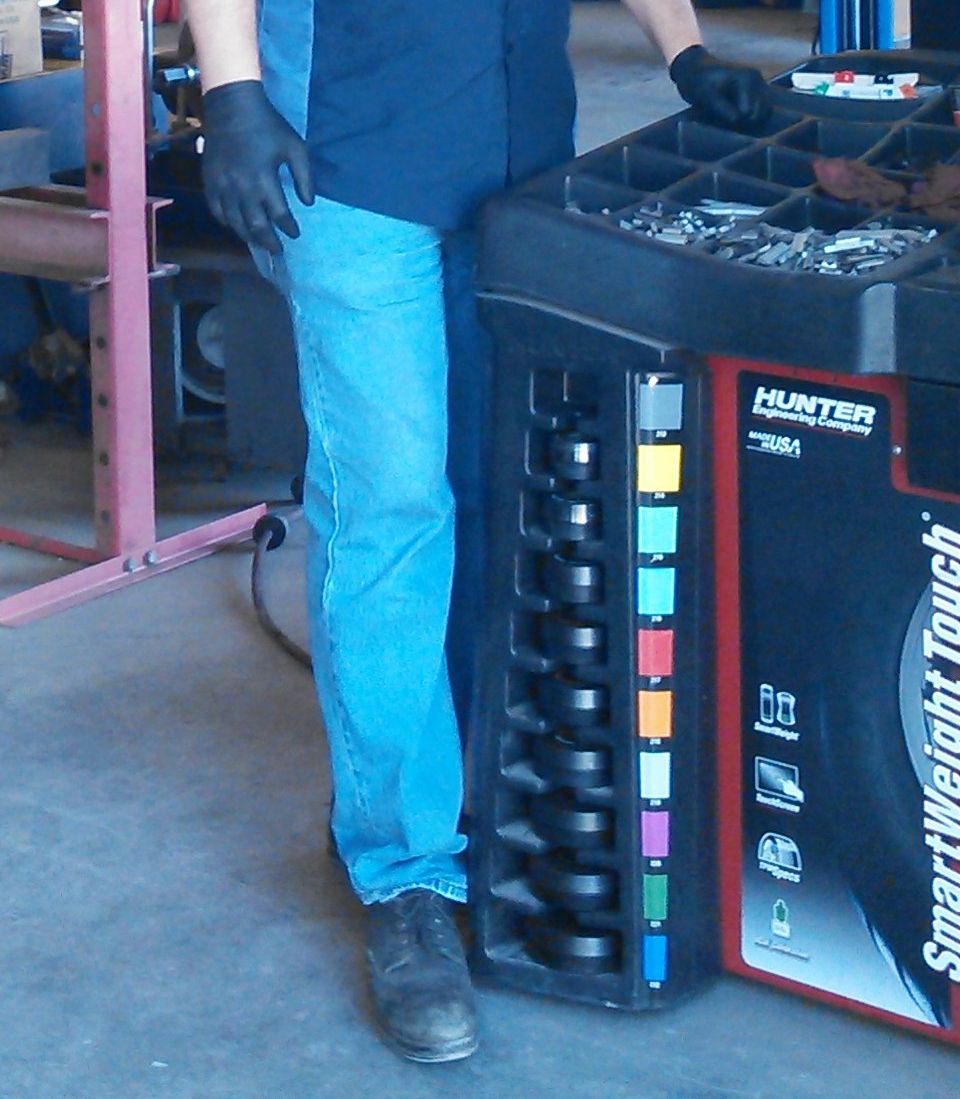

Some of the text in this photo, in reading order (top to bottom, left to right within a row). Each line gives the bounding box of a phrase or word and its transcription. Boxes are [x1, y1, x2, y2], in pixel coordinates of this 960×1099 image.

[754, 386, 877, 425] HUNTER
[752, 404, 873, 437] Engineering Company
[748, 430, 772, 441] MADE
[770, 434, 802, 455] USA
